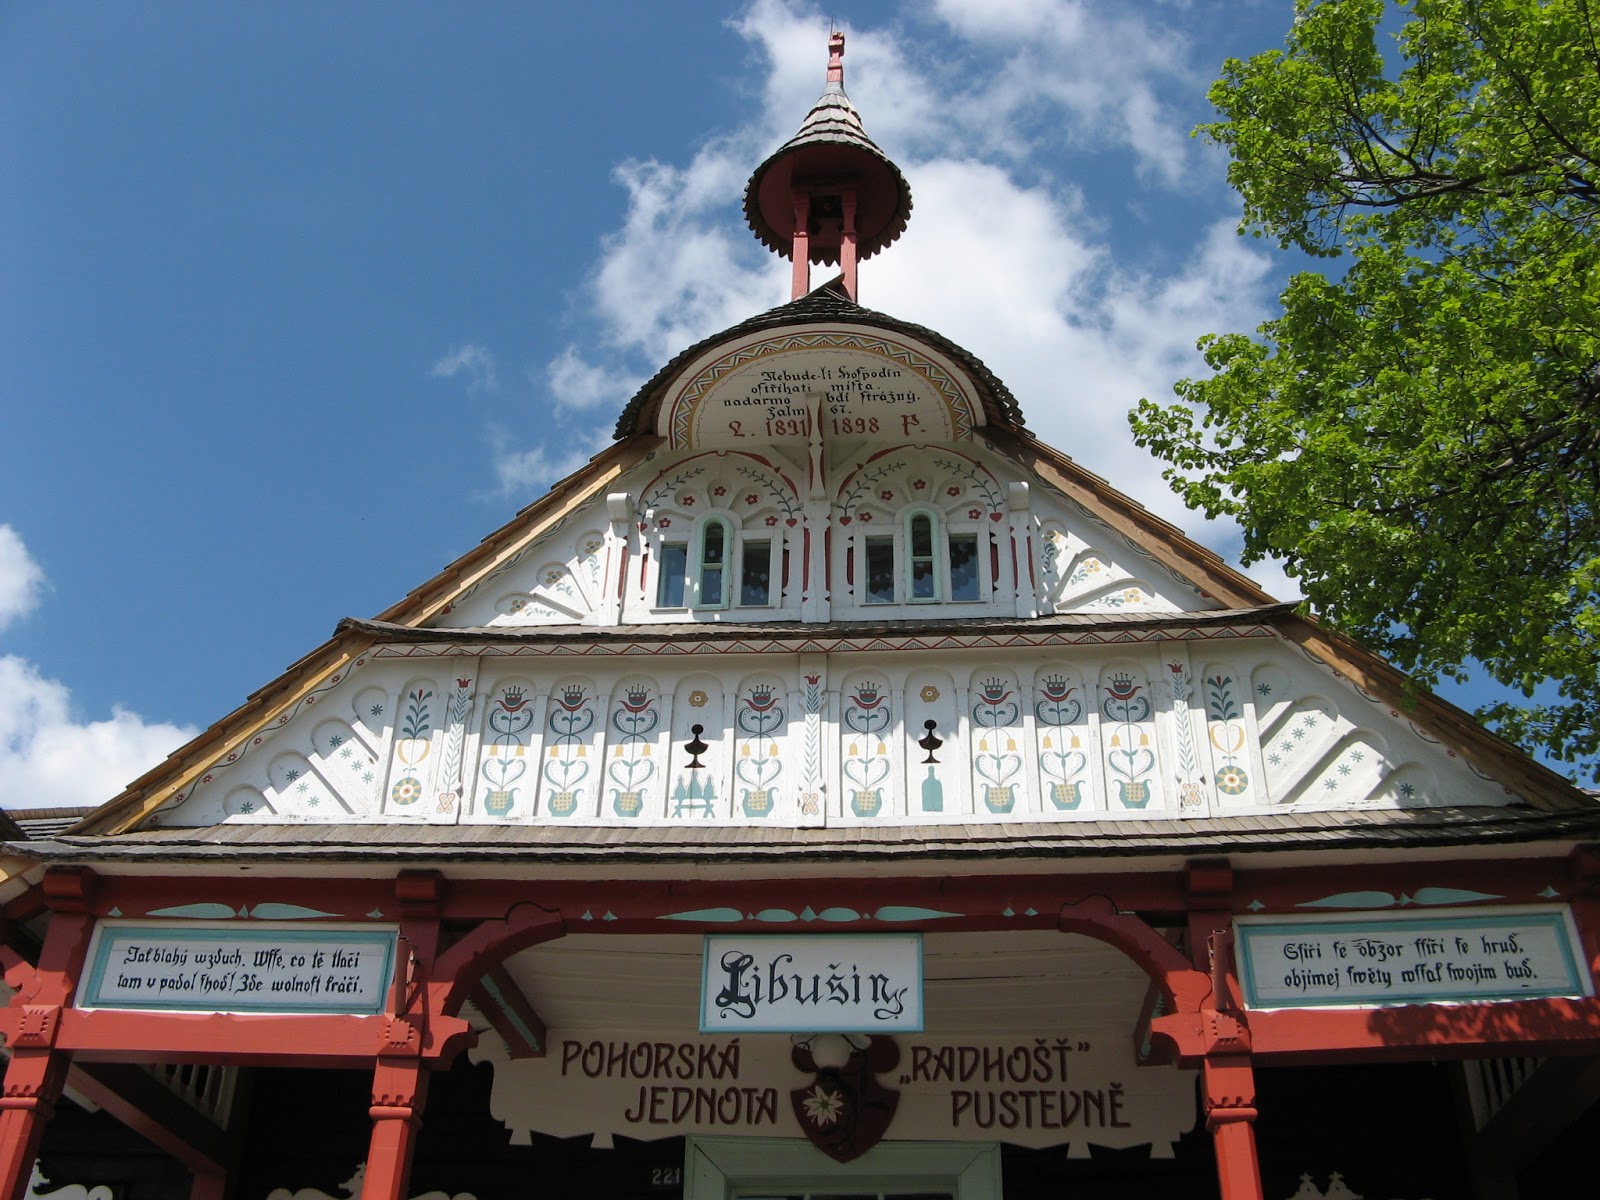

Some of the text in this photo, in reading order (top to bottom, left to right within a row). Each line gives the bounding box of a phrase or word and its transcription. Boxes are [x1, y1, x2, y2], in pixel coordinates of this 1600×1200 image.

[724, 396, 791, 407] nadarmo
[765, 419, 808, 437] 1891
[832, 416, 880, 436] 1898
[715, 950, 909, 1020] Libušin
[561, 1037, 741, 1080] POHORSKÁ
[624, 1085, 779, 1125] JEDNOTA
[651, 1167, 681, 1185] 221
